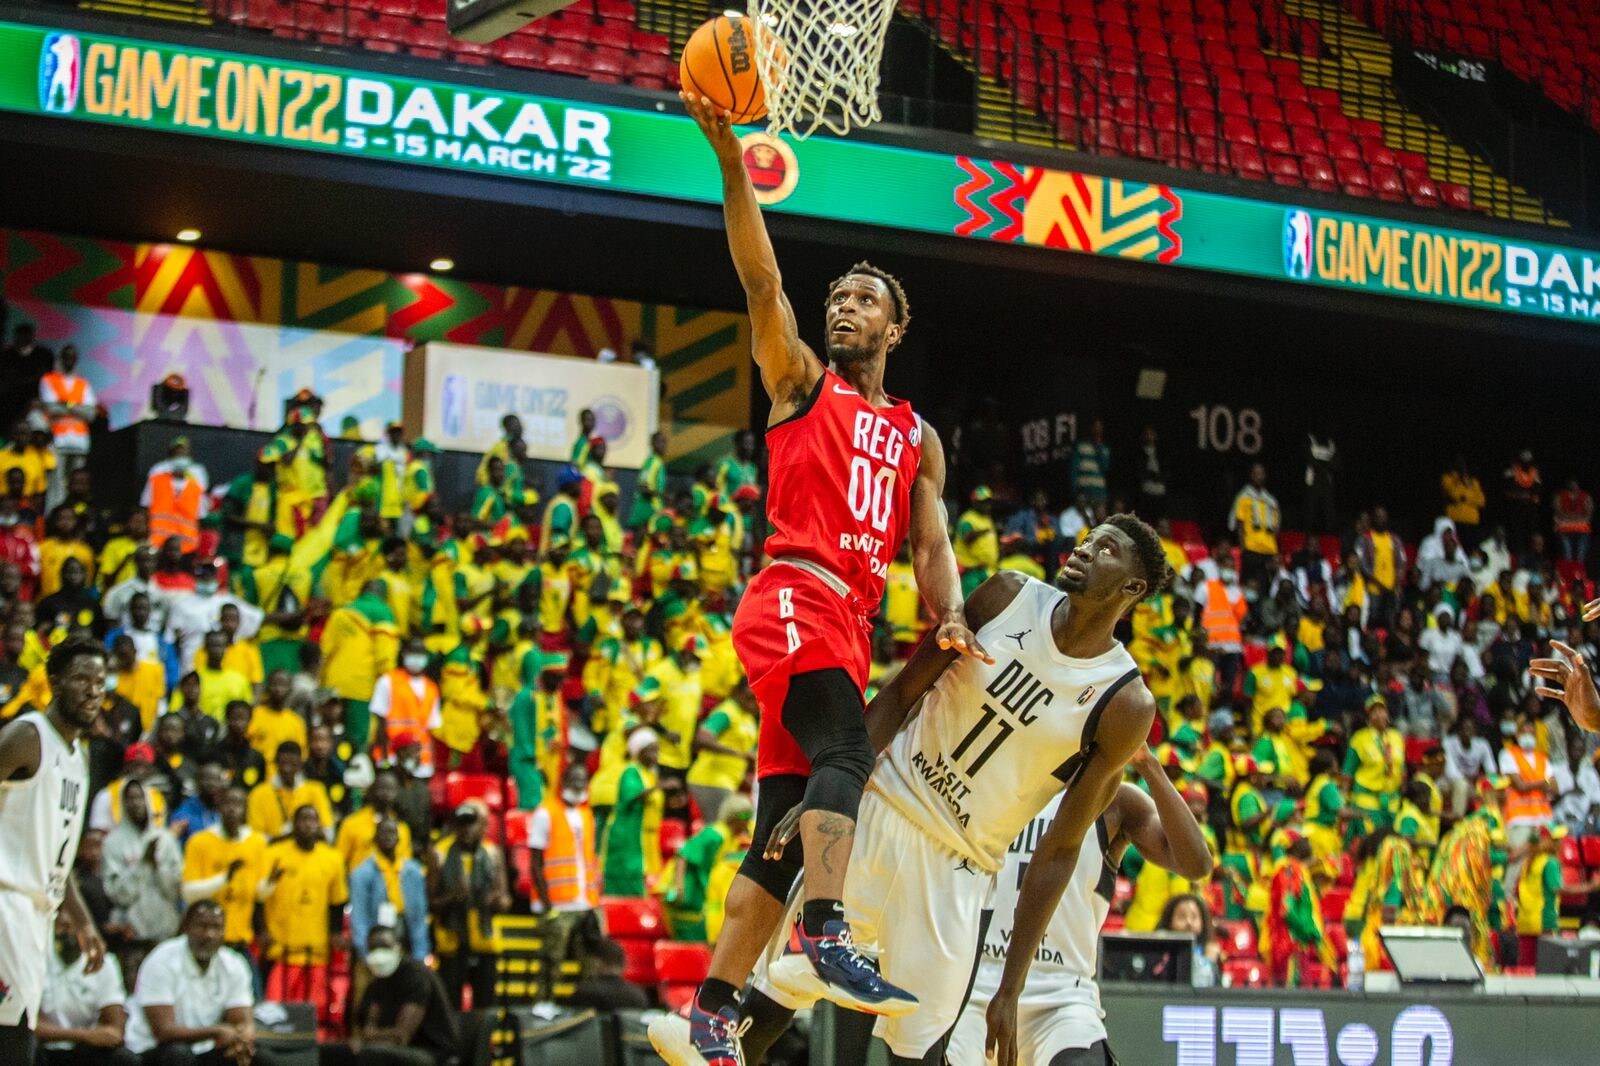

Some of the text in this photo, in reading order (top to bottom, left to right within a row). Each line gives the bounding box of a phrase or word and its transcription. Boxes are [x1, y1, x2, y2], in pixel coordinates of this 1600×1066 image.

[345, 77, 611, 157] DAKAR
[435, 139, 557, 174] MARCH
[563, 154, 612, 182] '22
[853, 409, 904, 467] REG
[1188, 404, 1263, 455] 108
[848, 455, 897, 534] 00
[986, 658, 1055, 727] DUC
[950, 702, 1015, 779] 11
